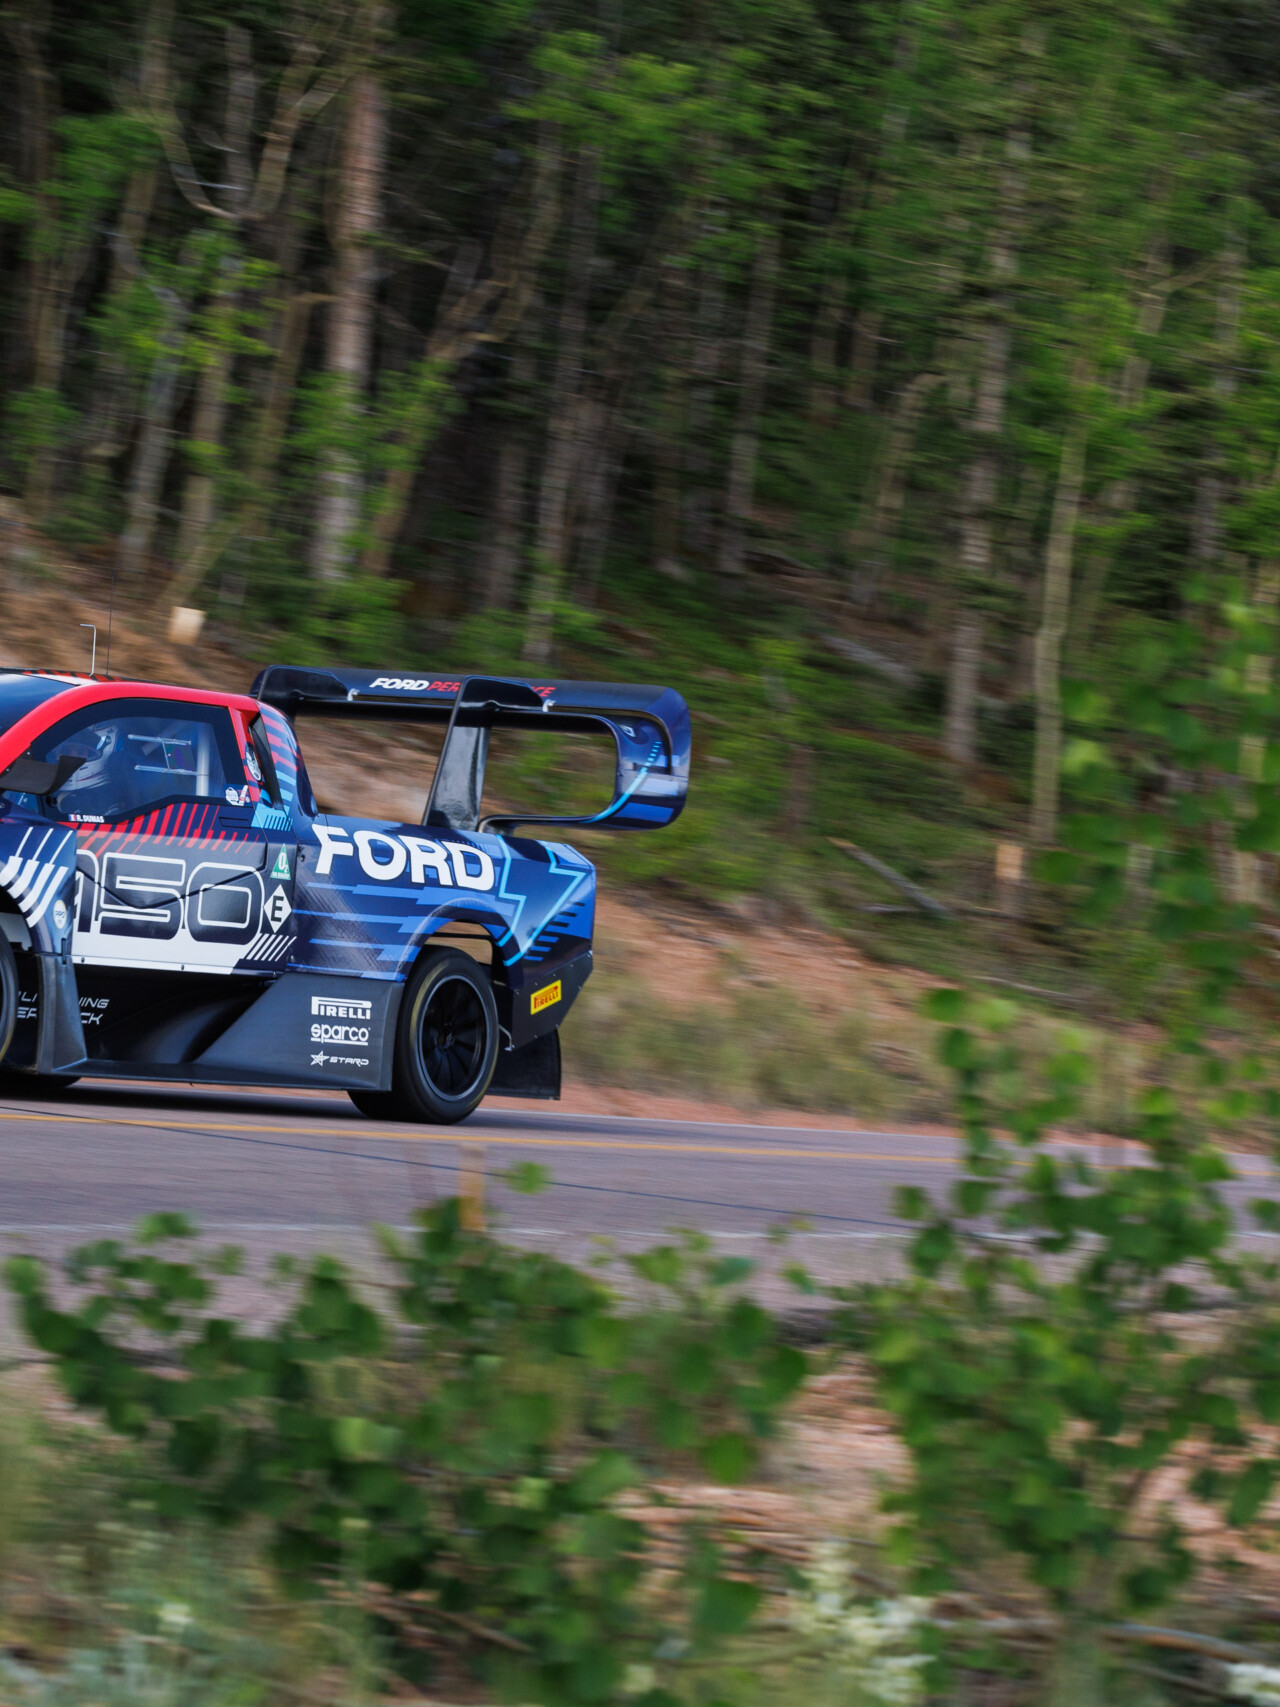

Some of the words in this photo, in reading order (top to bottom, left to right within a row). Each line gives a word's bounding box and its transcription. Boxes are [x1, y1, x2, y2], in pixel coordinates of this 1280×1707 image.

[370, 678, 430, 691] FORD
[82, 815, 105, 823] DUMAS
[311, 823, 495, 891] FORD
[270, 895, 284, 922] E
[311, 996, 372, 1020] PIRELLI
[534, 985, 559, 1009] PIRELLI
[310, 1023, 370, 1044] sparco
[329, 1056, 369, 1067] STARD
